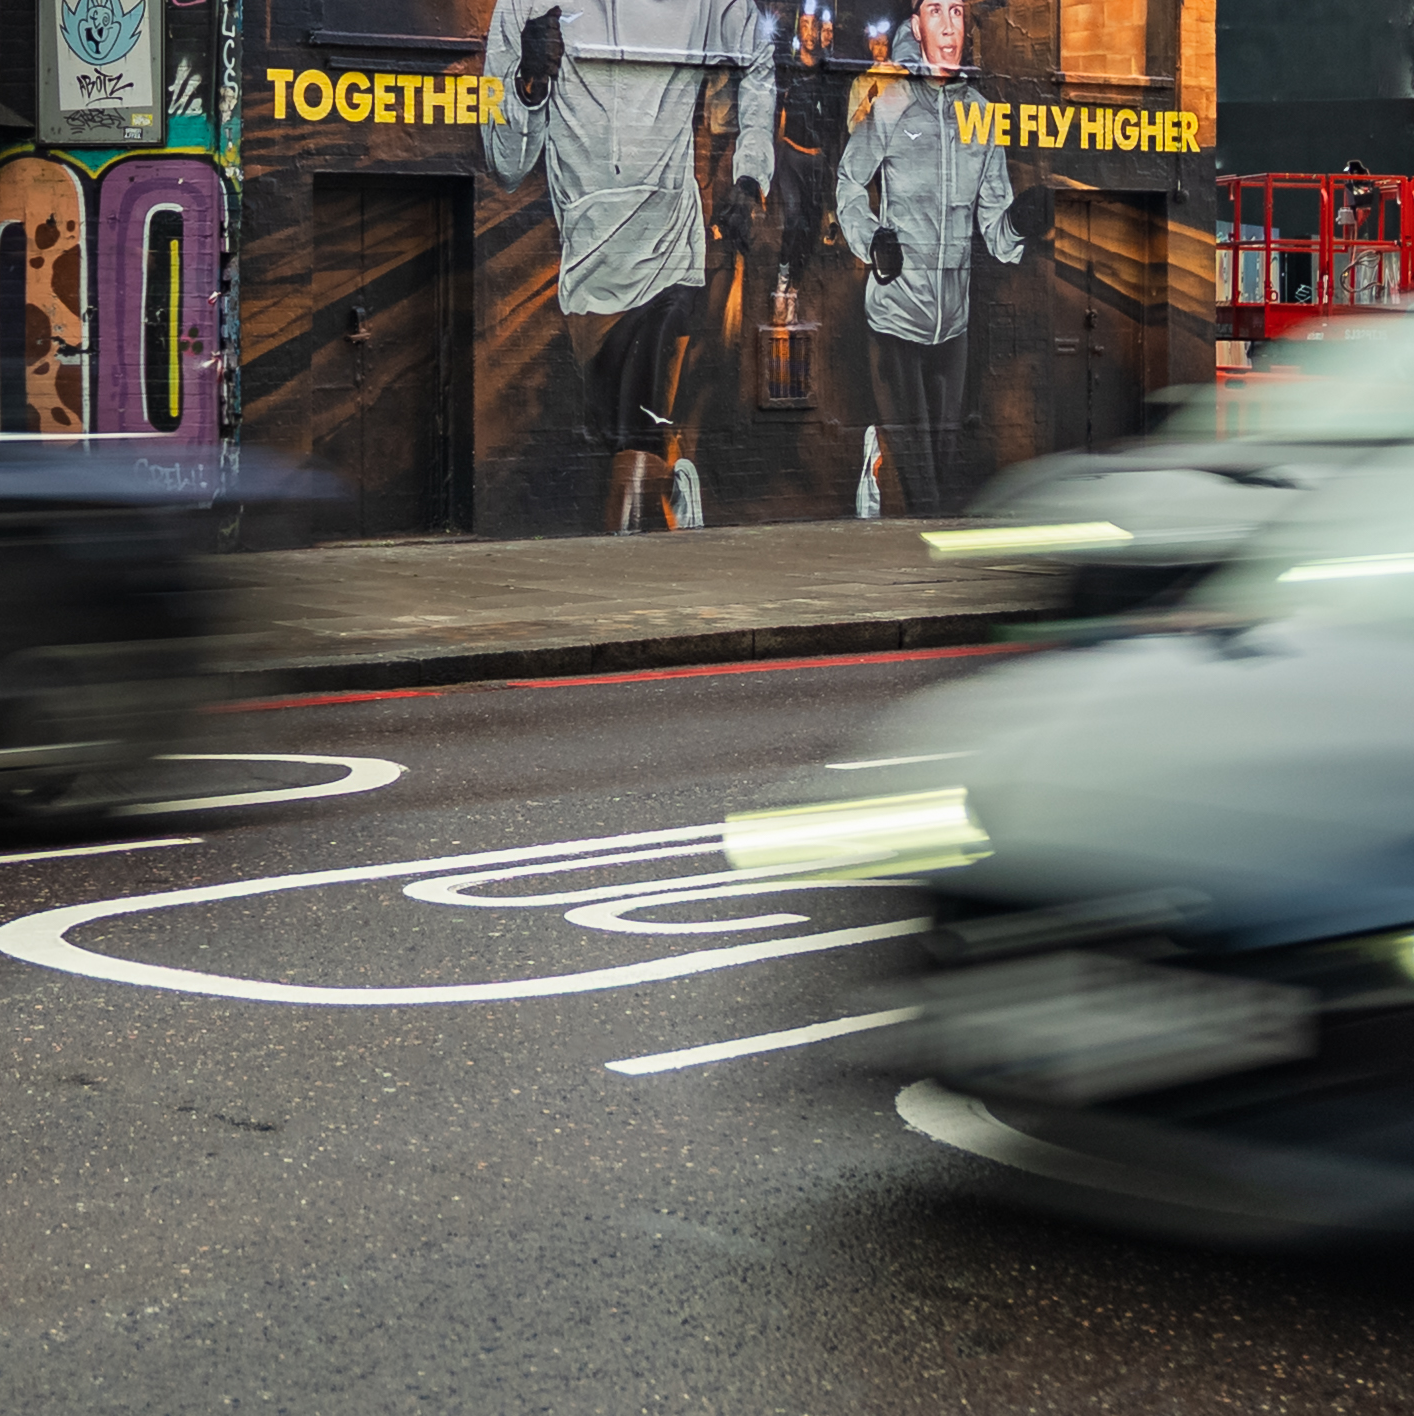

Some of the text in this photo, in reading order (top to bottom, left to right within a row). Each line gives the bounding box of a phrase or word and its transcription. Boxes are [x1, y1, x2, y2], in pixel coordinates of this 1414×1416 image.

[266, 68, 507, 125] TOGETHER
[953, 100, 1201, 153] WE FLY HIGHER
